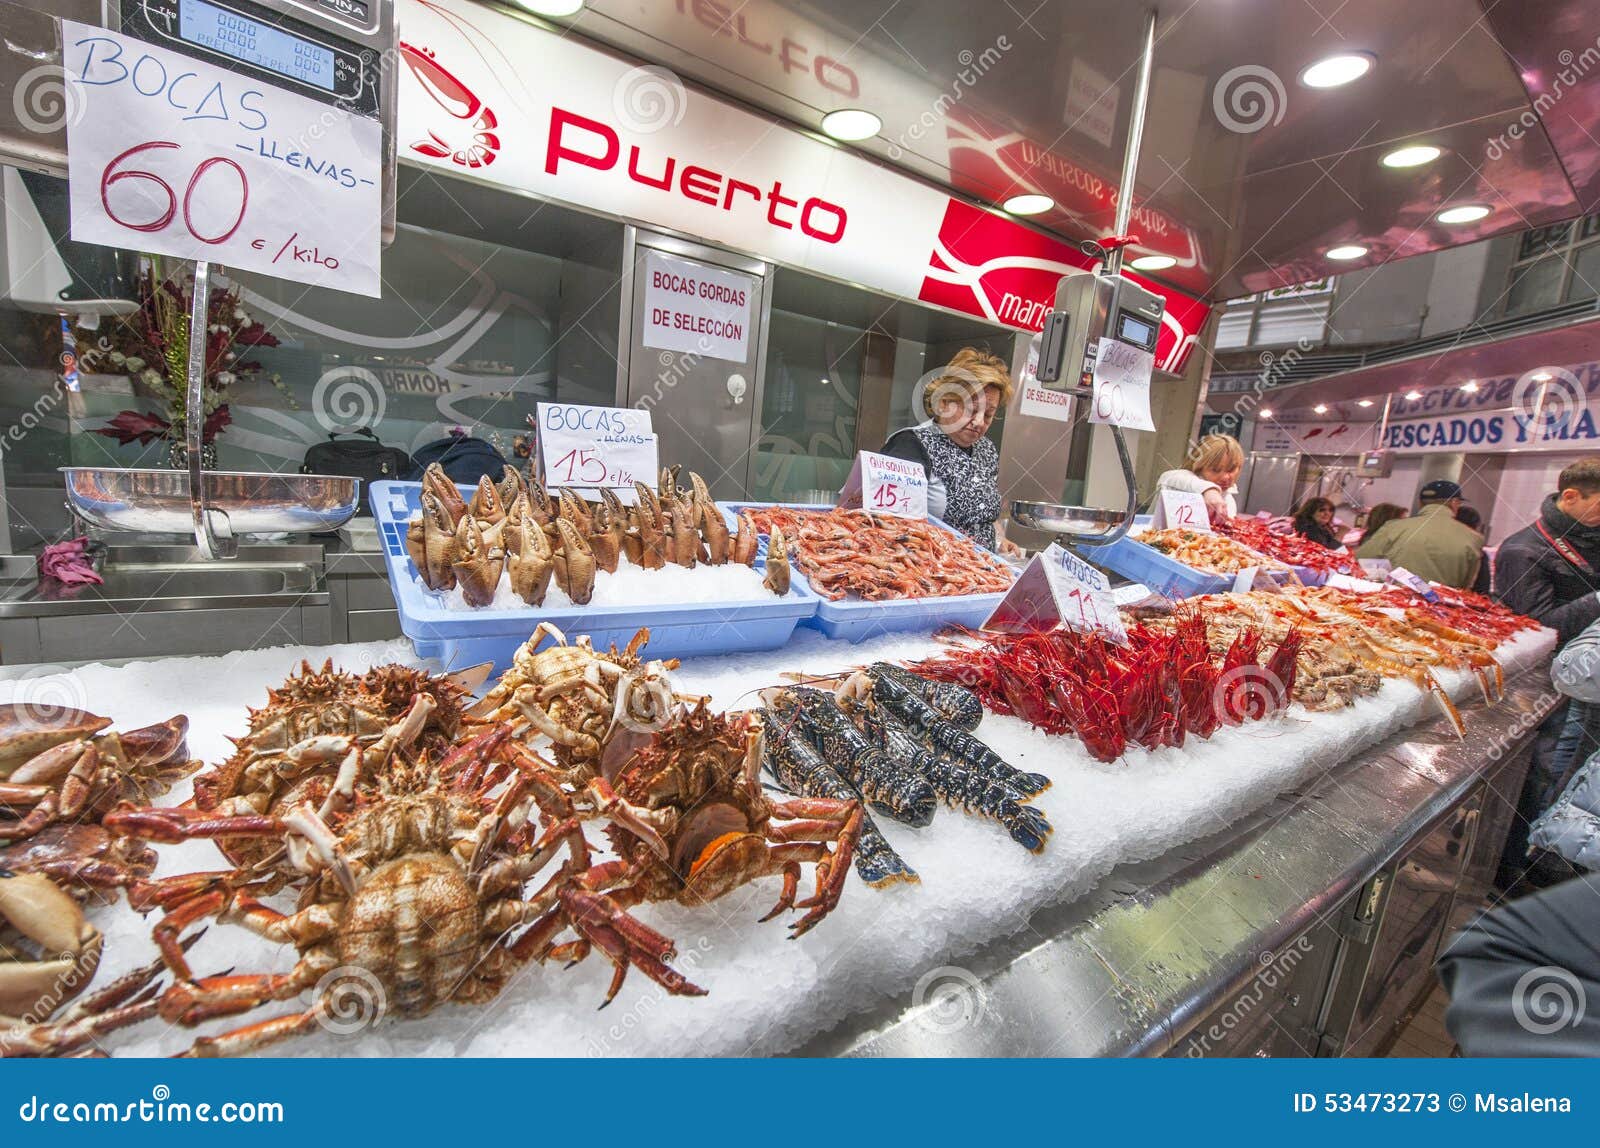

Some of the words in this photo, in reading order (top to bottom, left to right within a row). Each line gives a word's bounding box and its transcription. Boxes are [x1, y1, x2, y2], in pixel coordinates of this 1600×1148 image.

[73, 37, 268, 131] BOCAS
[544, 106, 848, 244] Puerto
[101, 141, 249, 245] 60
[653, 271, 696, 296] BOCAS
[699, 281, 746, 307] GORDAS
[652, 308, 671, 327] DE
[673, 312, 742, 341] SELECCIÓN
[1026, 388, 1034, 401] DE
[546, 405, 626, 434] BOCAS
[1513, 413, 1536, 443] Y
[553, 448, 607, 483] 15
[873, 483, 898, 507] 15
[1175, 504, 1195, 525] 12
[1061, 551, 1101, 591] ROJOS
